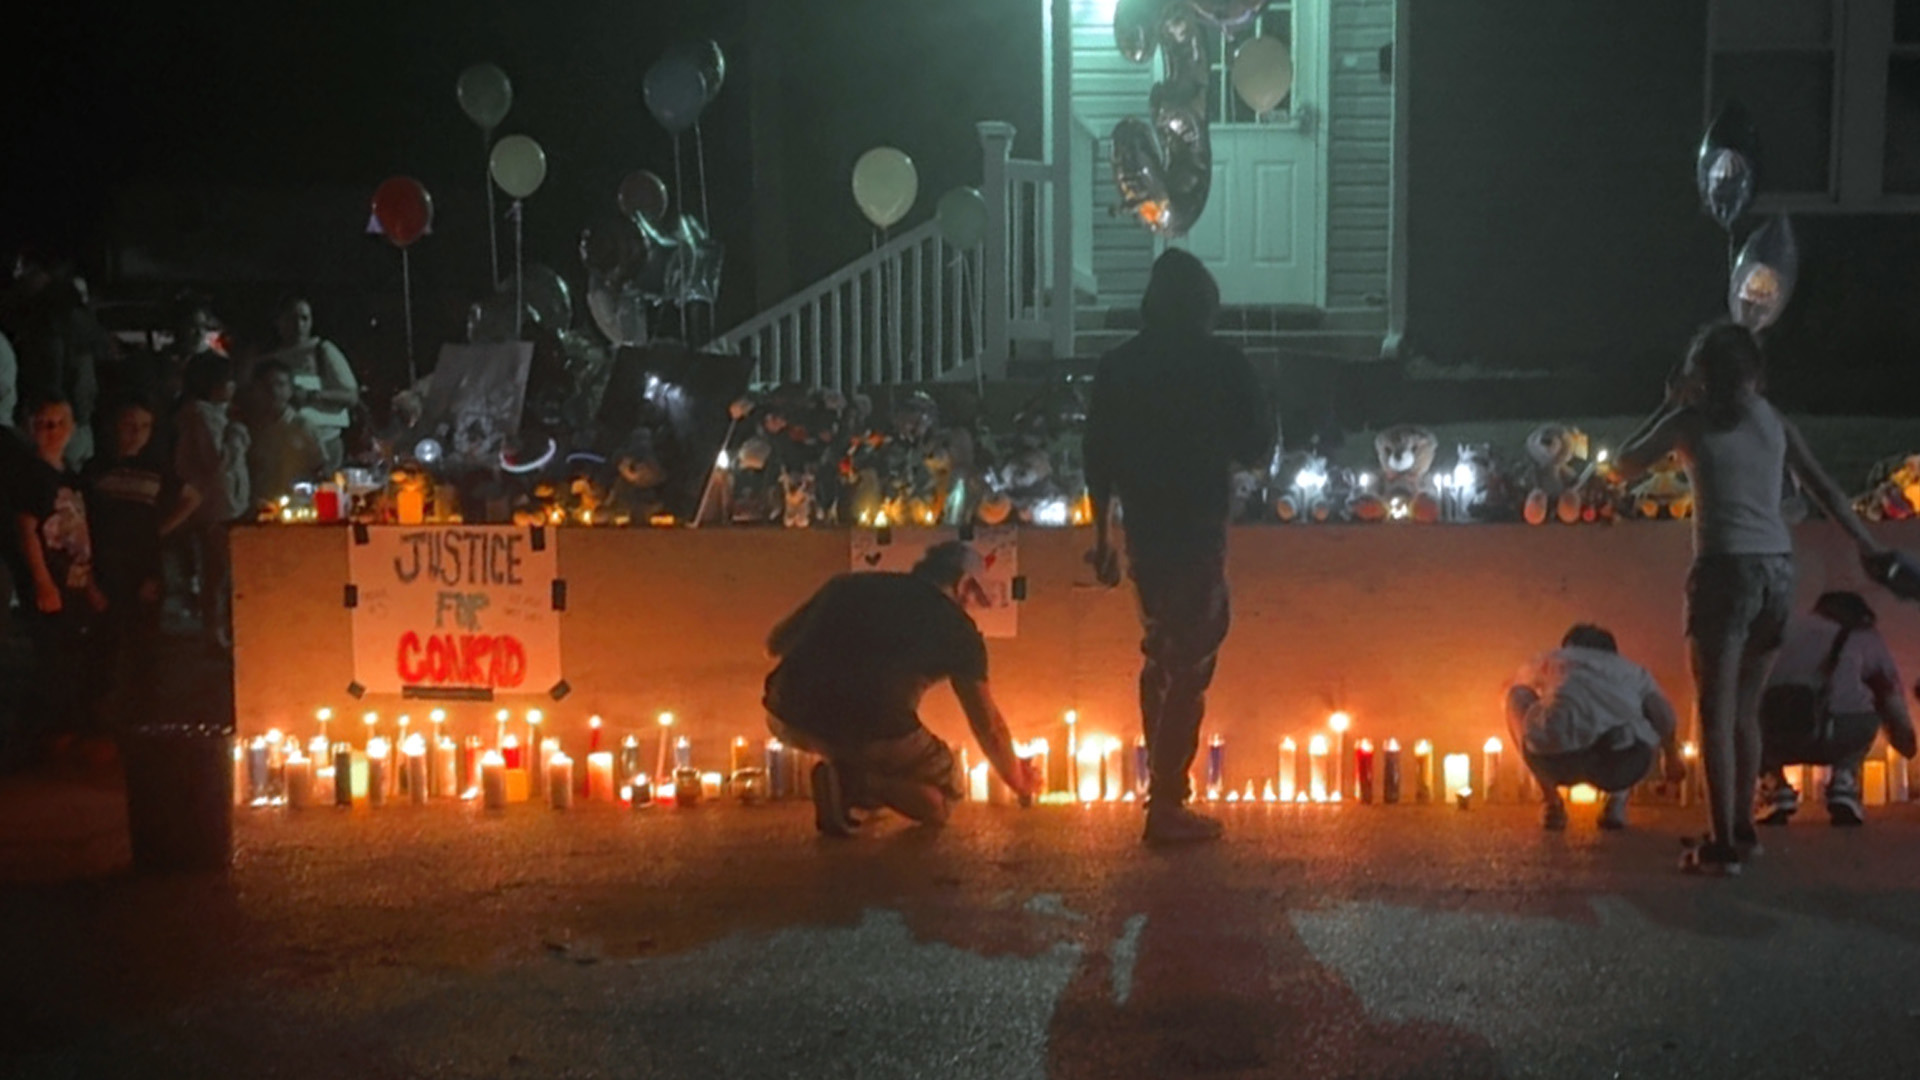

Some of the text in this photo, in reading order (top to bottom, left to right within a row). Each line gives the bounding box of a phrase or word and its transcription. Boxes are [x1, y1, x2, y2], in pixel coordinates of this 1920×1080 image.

[394, 529, 522, 586] JUSTICE
[436, 592, 490, 631] FOR
[397, 631, 527, 688] CONRAD
